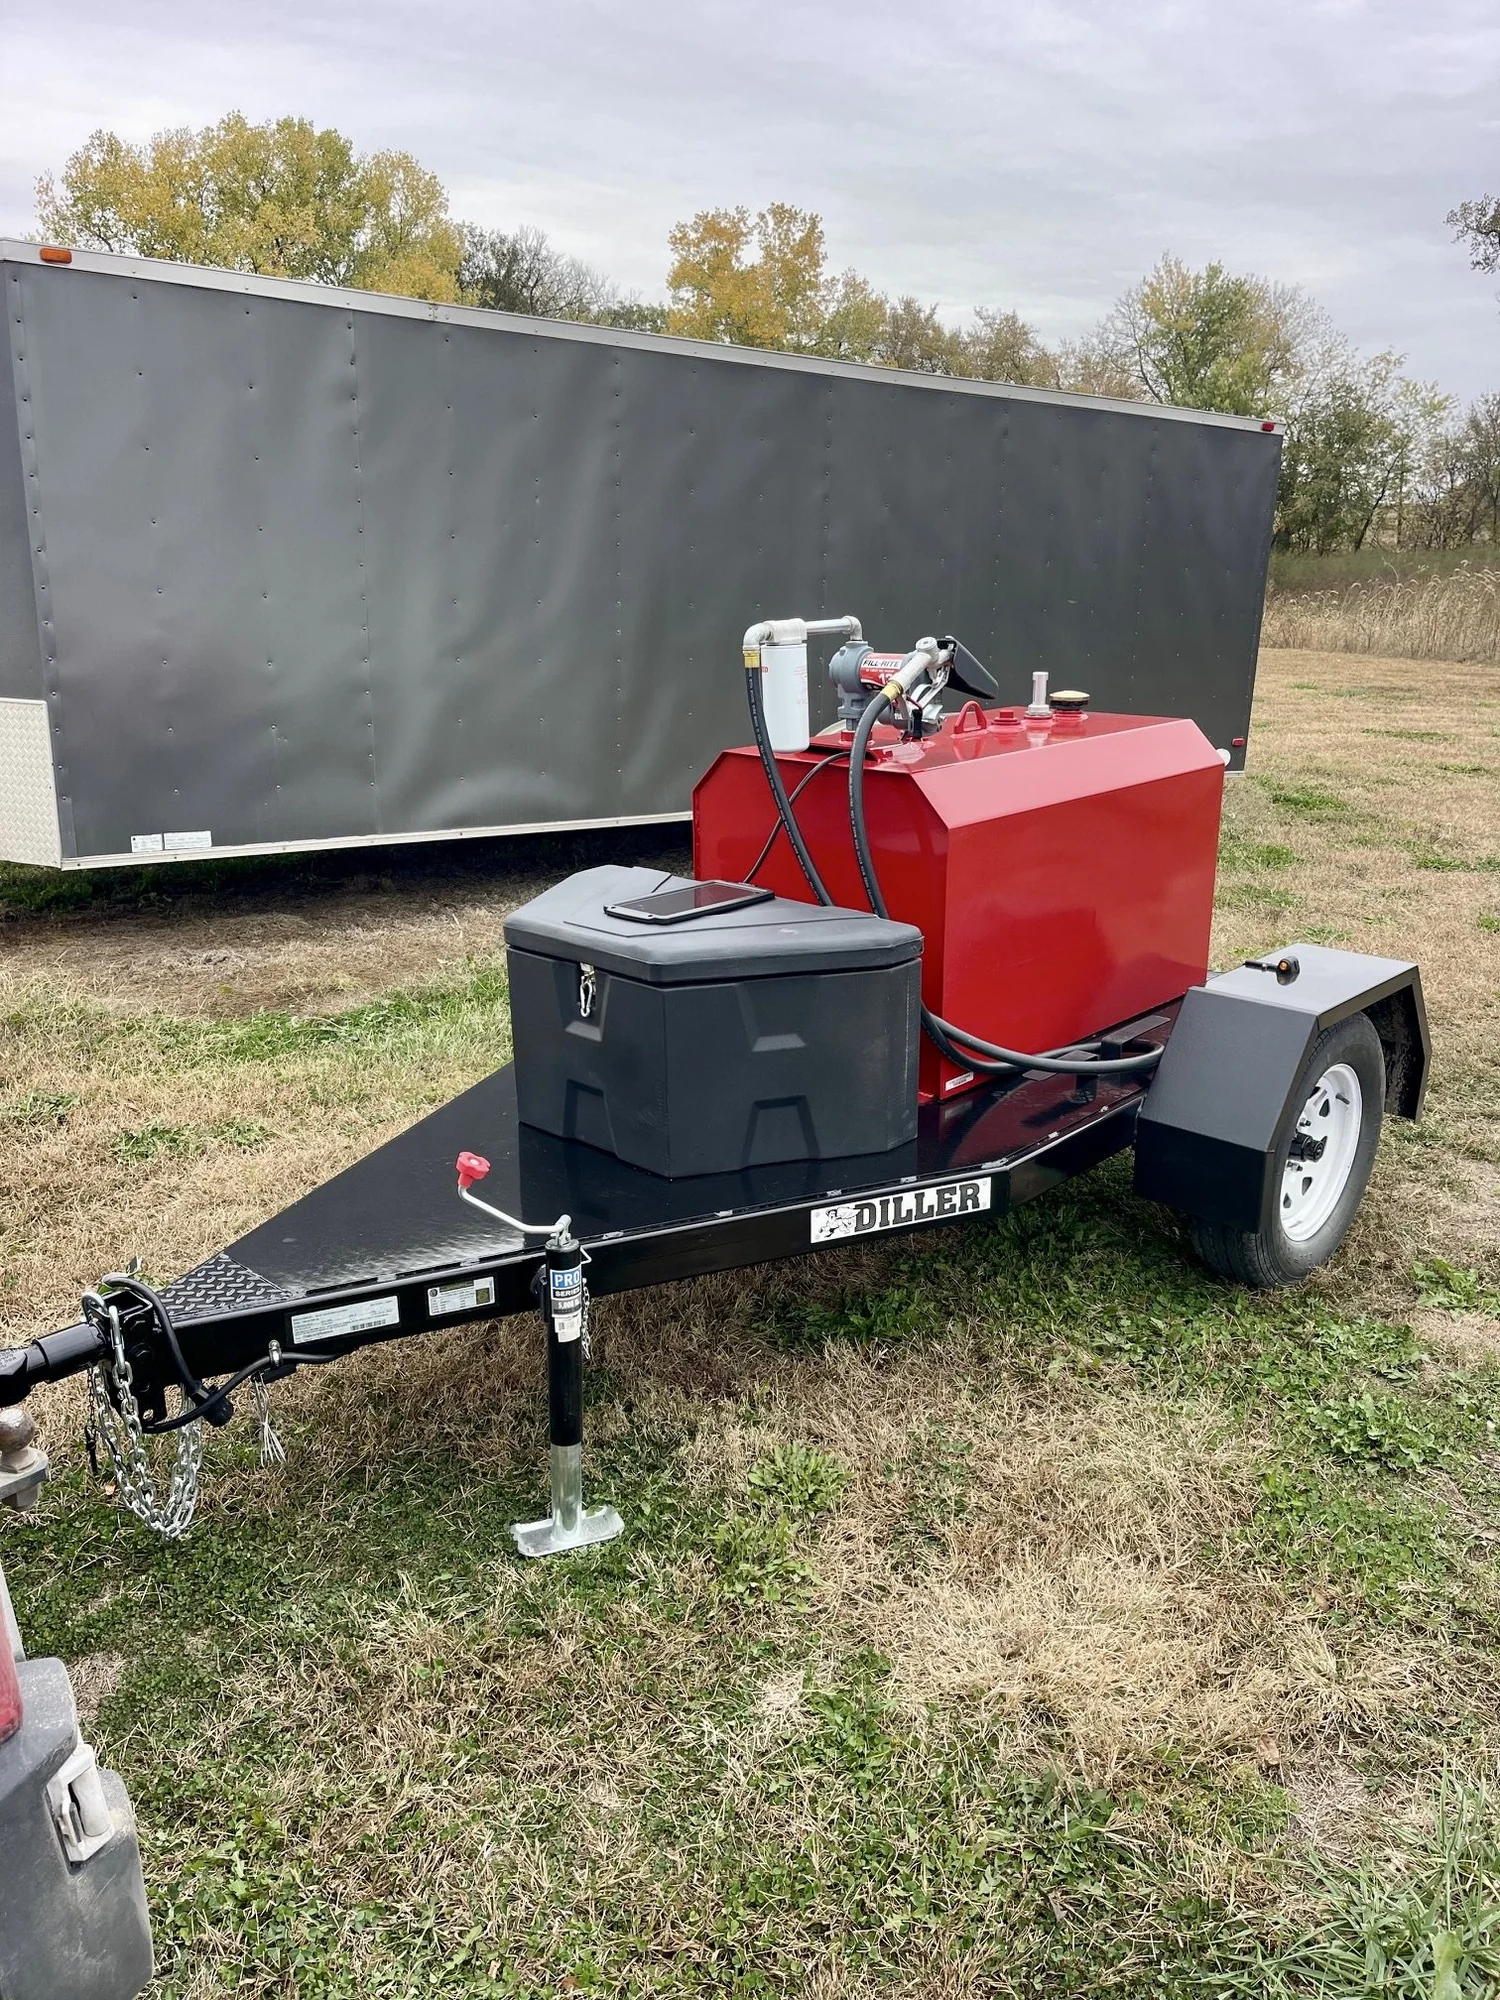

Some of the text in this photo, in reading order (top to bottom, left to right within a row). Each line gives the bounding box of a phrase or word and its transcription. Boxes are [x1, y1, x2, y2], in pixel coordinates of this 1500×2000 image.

[862, 660, 899, 668] FILL-RITE
[854, 1182, 980, 1232] DILLER
[554, 1270, 580, 1287] PRO
